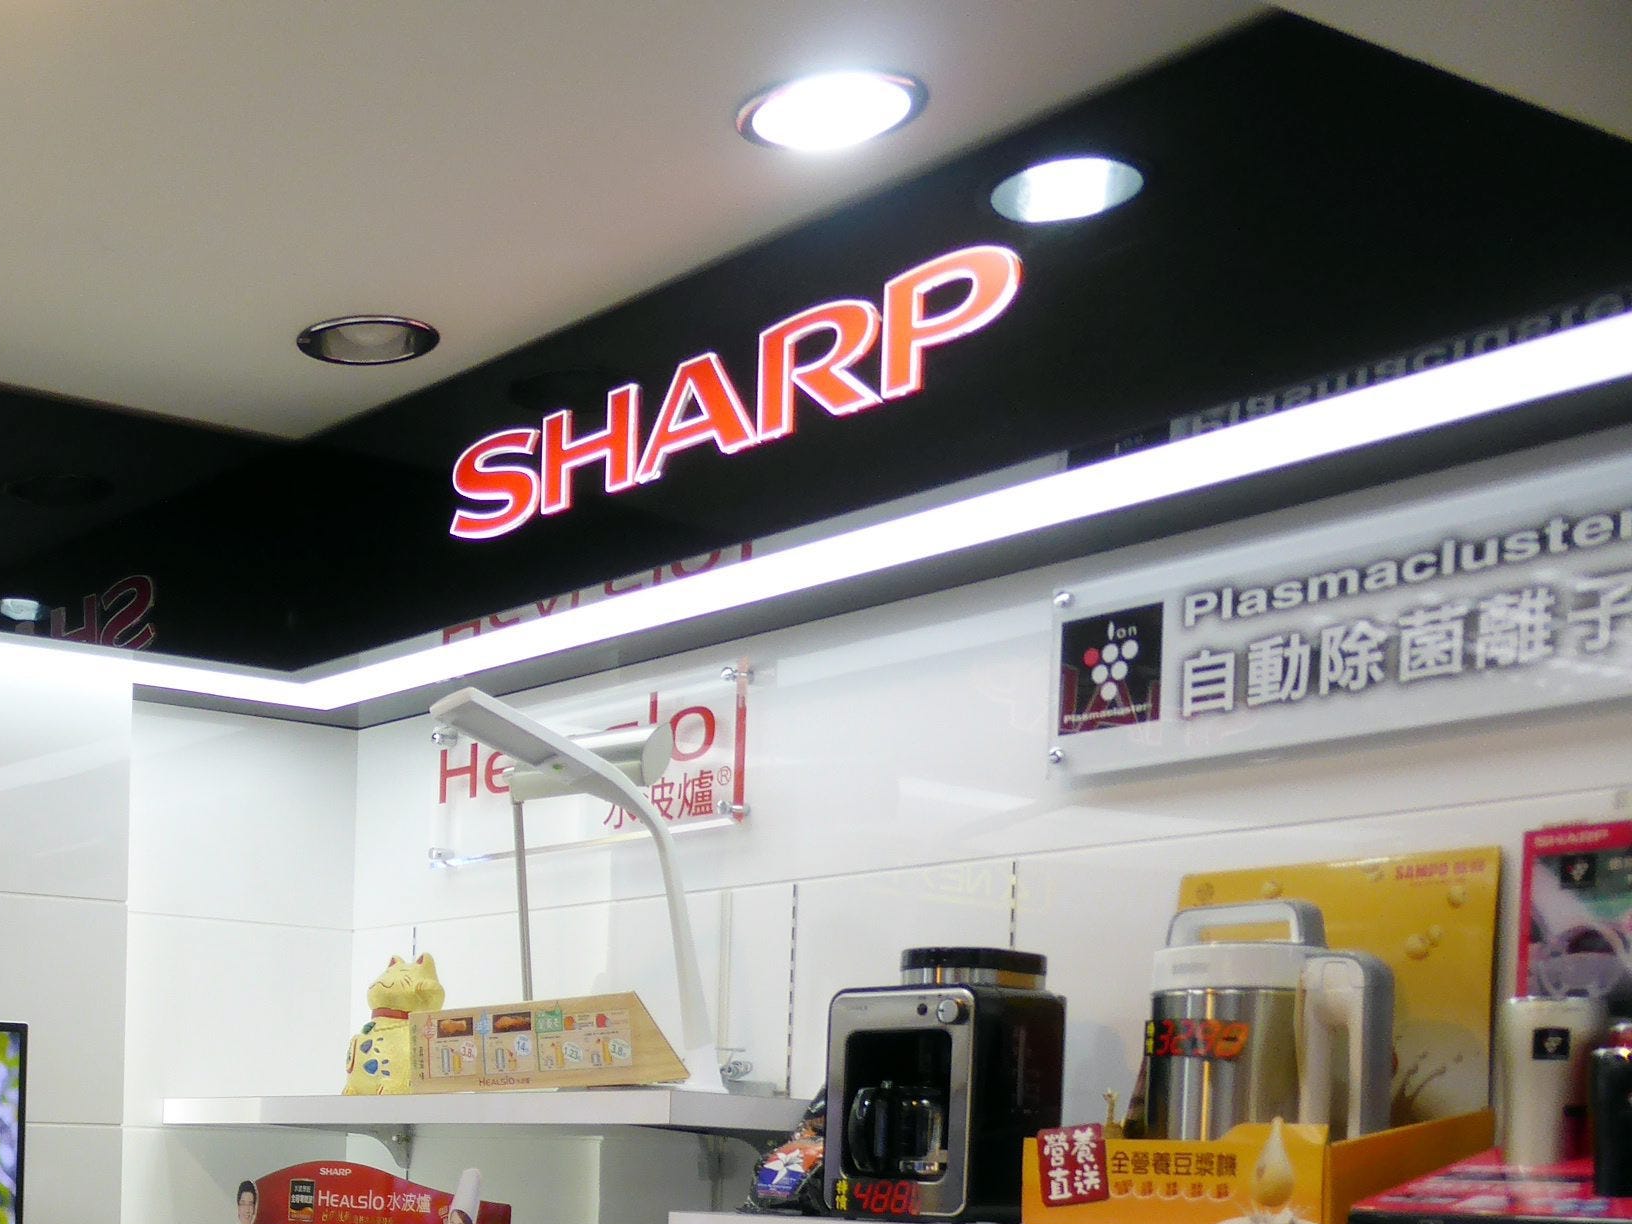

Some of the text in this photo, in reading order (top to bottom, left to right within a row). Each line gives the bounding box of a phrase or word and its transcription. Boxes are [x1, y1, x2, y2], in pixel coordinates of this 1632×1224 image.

[450, 244, 1023, 540] SHARP
[1181, 572, 1632, 719] 自動除菌離子
[1043, 1128, 1097, 1168] 營養
[319, 1167, 352, 1177] SHARP
[1048, 1167, 1100, 1201] 直送
[386, 1193, 431, 1213] 水波爐
